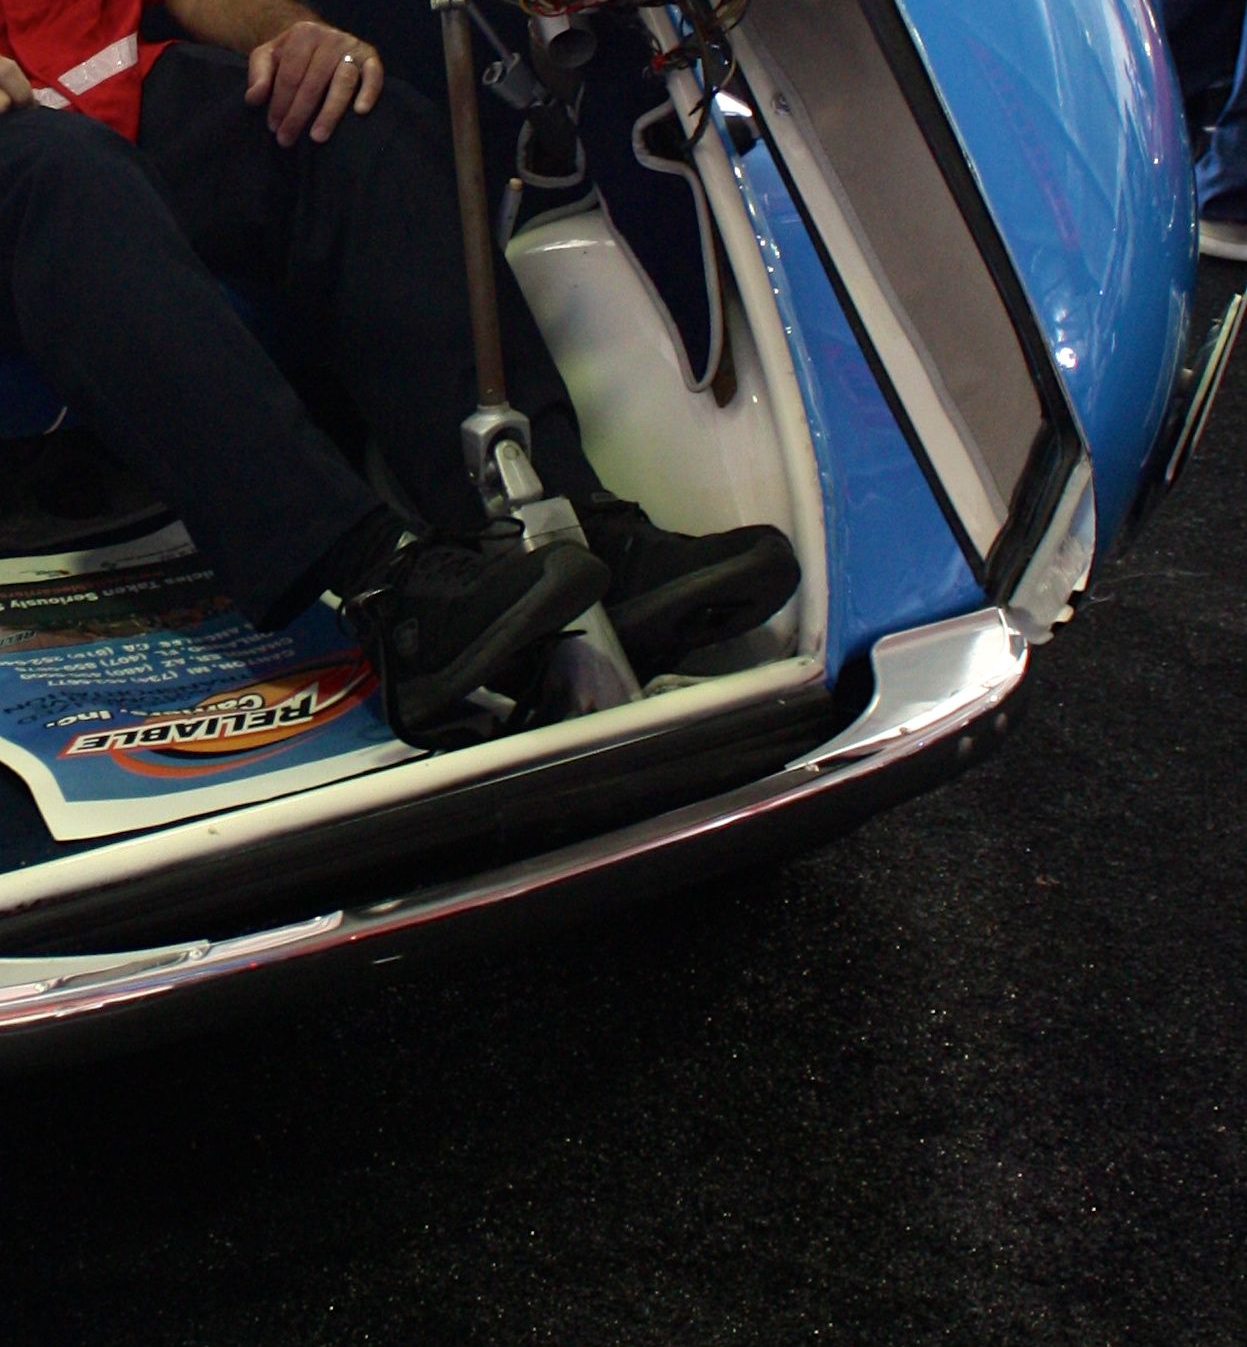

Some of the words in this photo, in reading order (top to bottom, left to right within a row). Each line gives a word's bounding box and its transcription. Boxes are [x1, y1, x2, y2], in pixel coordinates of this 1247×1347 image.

[102, 581, 161, 597] Taken
[10, 592, 99, 609] Seriously
[160, 657, 186, 668] AZ
[45, 709, 114, 730] Inc.
[66, 685, 318, 754] RELIABLE
